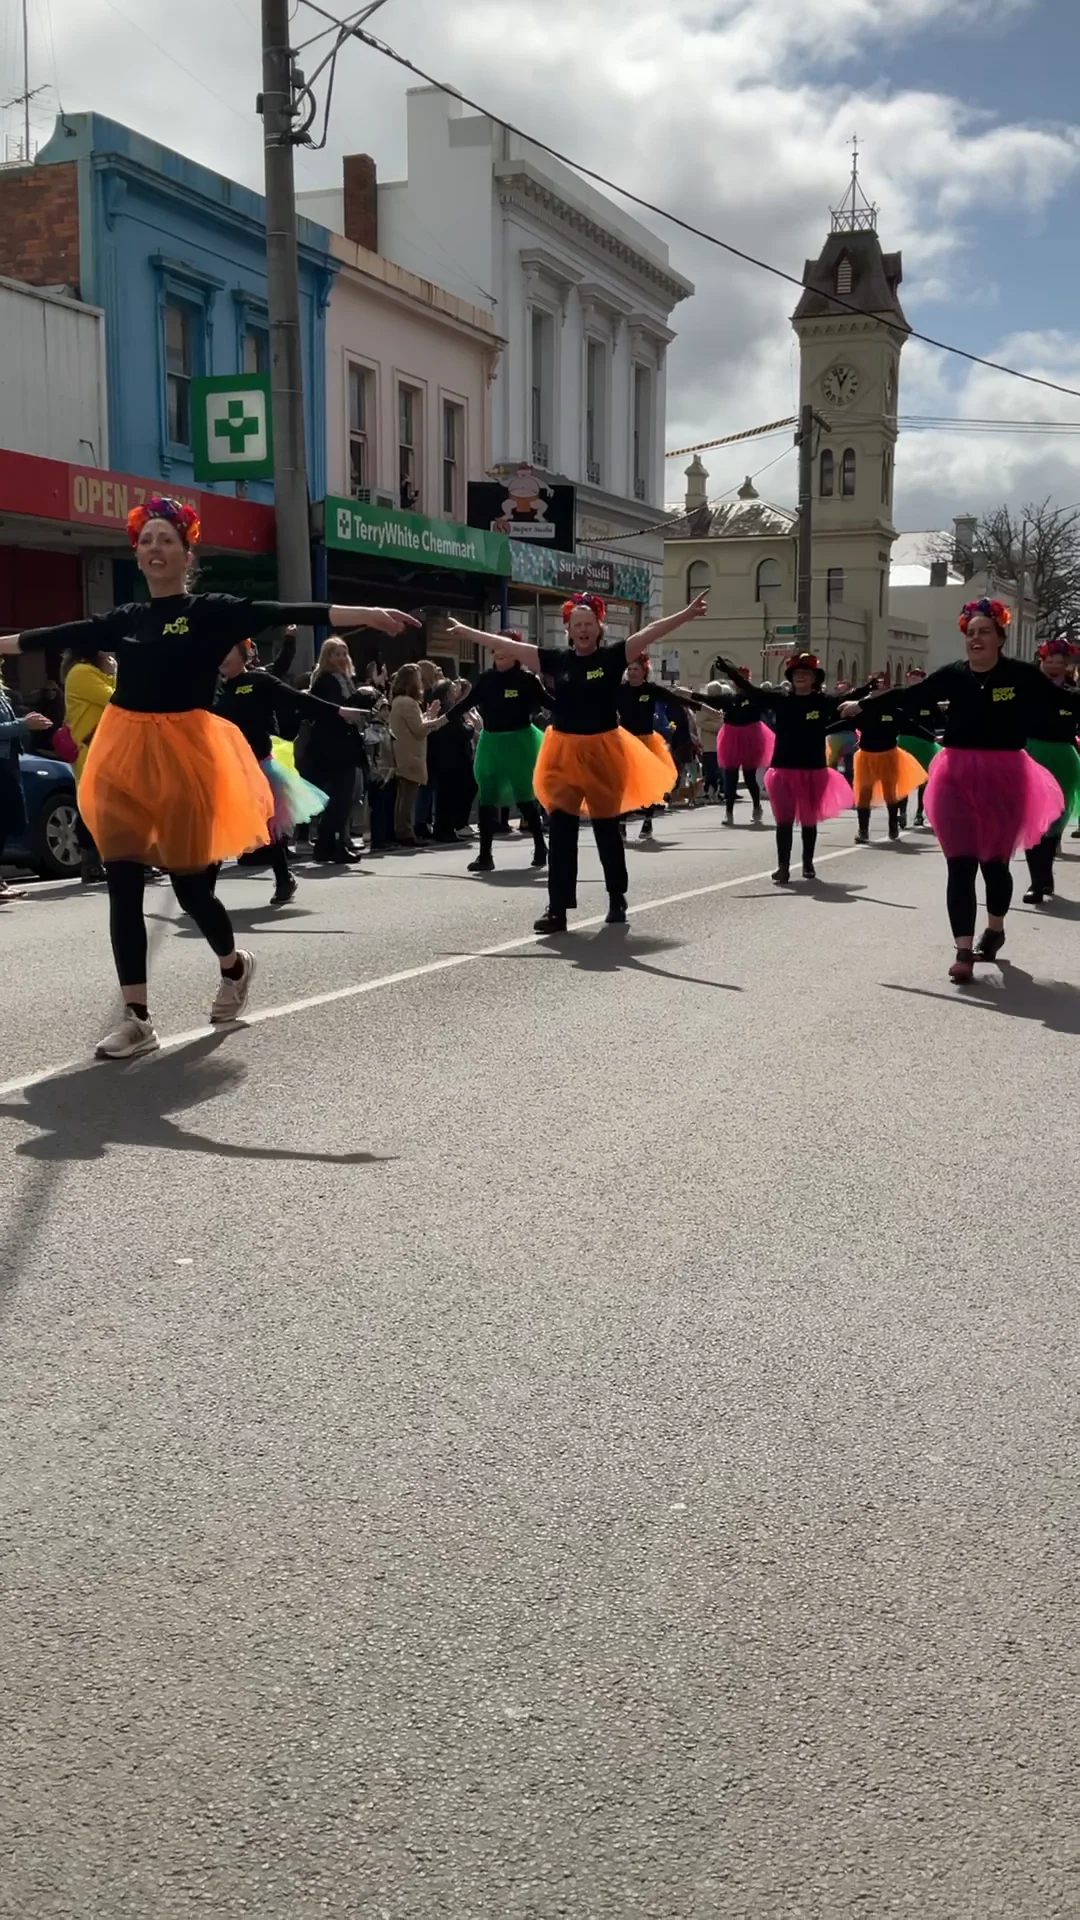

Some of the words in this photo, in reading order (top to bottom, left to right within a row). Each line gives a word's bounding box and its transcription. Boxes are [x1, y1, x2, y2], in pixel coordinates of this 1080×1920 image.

[73, 475, 128, 520] OPEN
[353, 514, 420, 549] TerryWhite
[421, 530, 476, 560] Chemmart
[512, 524, 533, 535] Super
[534, 524, 553, 533] Sushi
[559, 558, 586, 580] Super
[586, 563, 610, 580] Sushi
